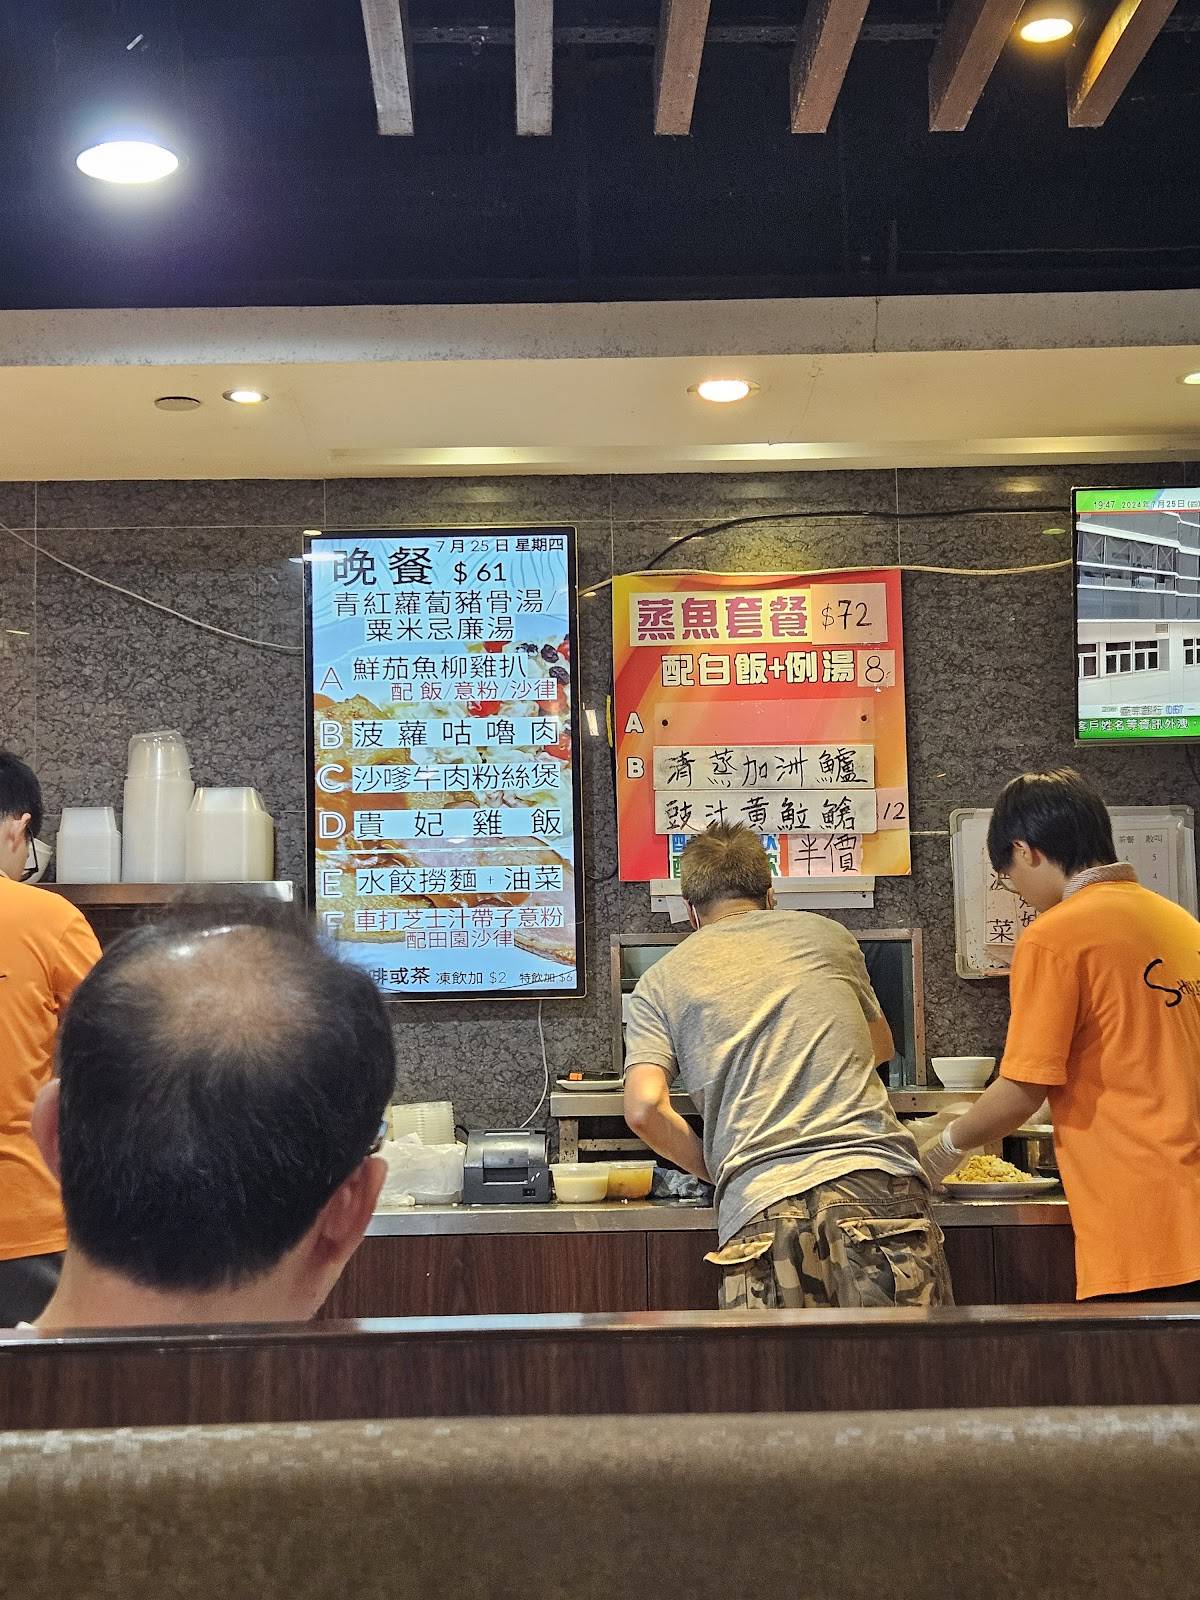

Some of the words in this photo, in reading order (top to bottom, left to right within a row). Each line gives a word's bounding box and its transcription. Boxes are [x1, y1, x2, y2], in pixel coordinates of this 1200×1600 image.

[1094, 501, 1115, 509] 19:47
[333, 546, 433, 587] 晚餐
[637, 595, 808, 641] 蒸魚套餐
[821, 599, 872, 631] $72
[366, 616, 515, 642] 粟米忌廉湯
[320, 667, 343, 691] A
[353, 655, 527, 682] 鮮茄魚柳雞扒
[661, 650, 855, 688] 配白飯+例湯
[319, 722, 344, 749] B
[353, 719, 559, 748] 菠蘿咕嚕肉
[625, 711, 644, 733] A
[316, 764, 345, 793] C
[353, 763, 559, 792] 沙嗲牛肉粉絲煲
[626, 757, 645, 778] B
[319, 811, 347, 838] D
[355, 808, 562, 838] 貴妃雞飯
[795, 833, 859, 876] 半價
[321, 868, 343, 898] E
[356, 907, 564, 930] 車打芝士汁帶子意粉
[986, 918, 1014, 943] 菜
[406, 929, 514, 949] 配田園沙律
